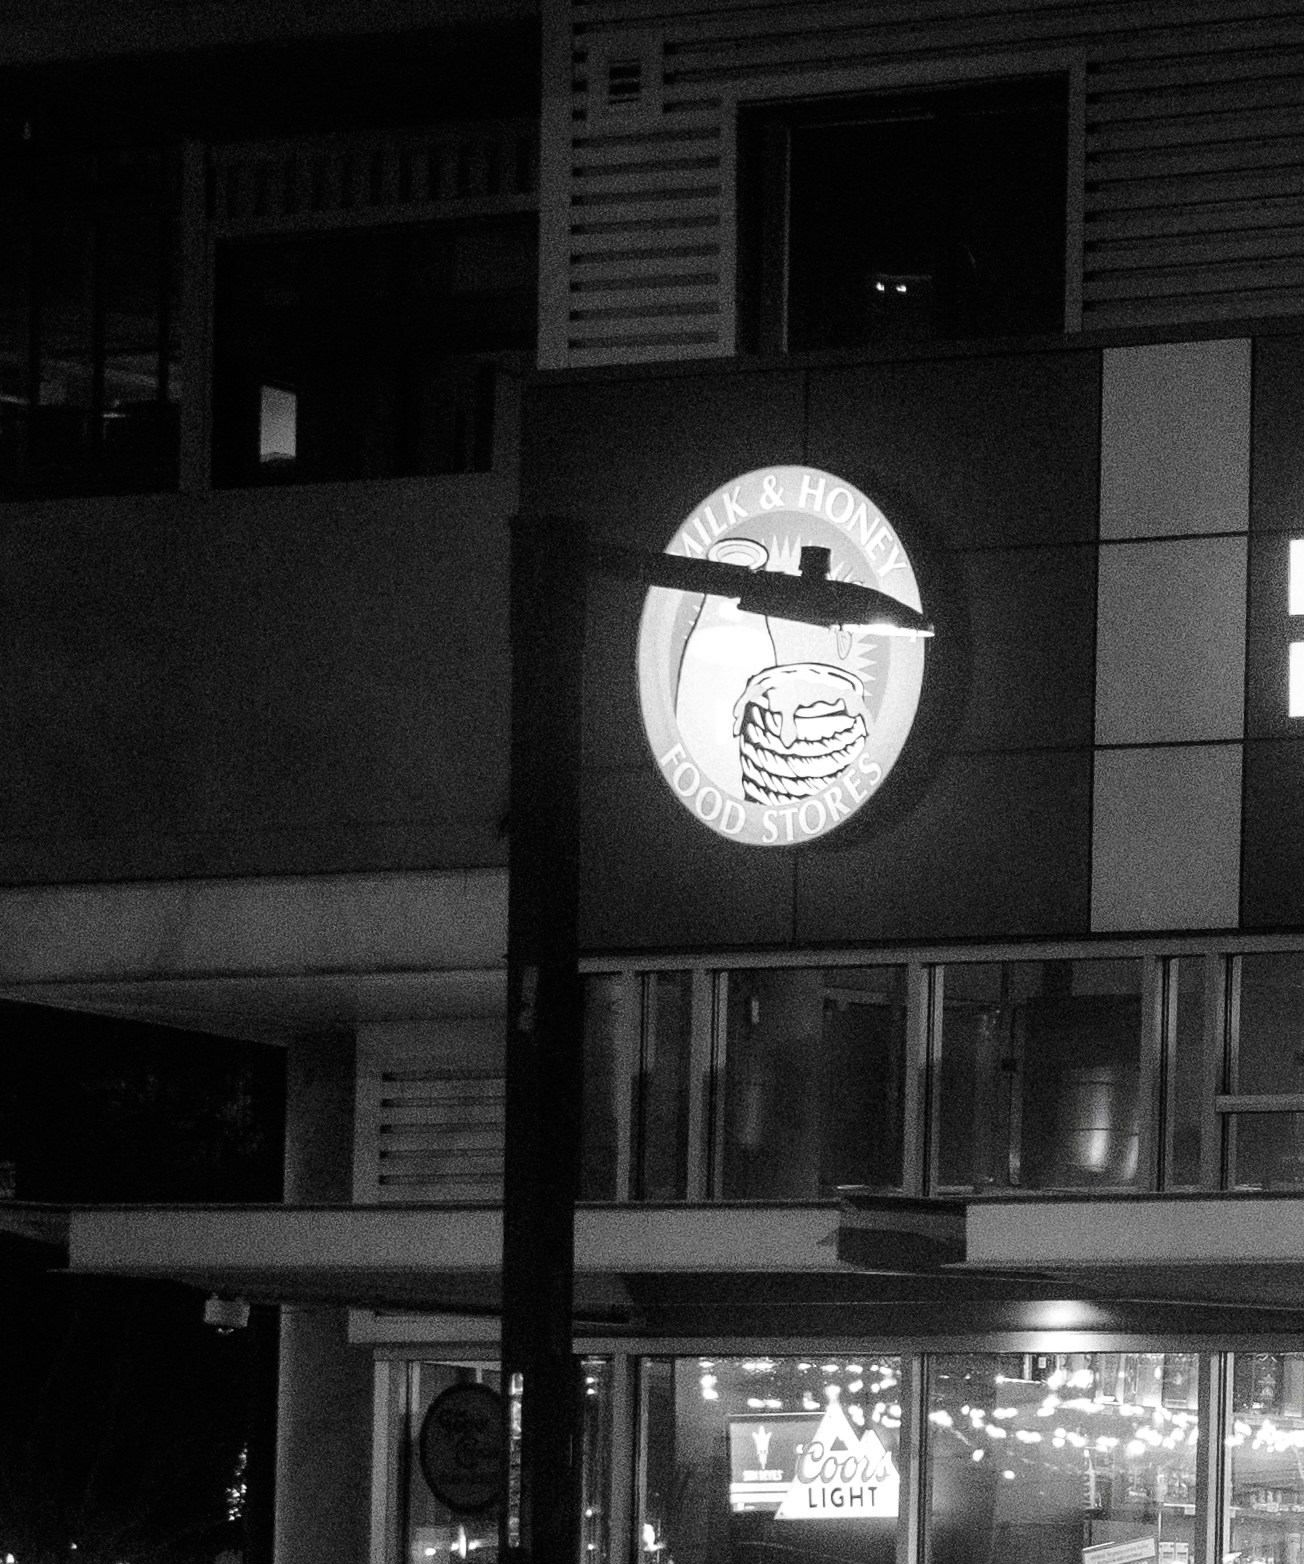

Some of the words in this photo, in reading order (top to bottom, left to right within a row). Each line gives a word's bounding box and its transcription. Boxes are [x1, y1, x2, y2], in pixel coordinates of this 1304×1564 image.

[760, 475, 785, 510] &
[799, 475, 908, 578] HONEY
[660, 743, 746, 835] FOOD
[762, 751, 882, 843] STORES
[797, 1441, 892, 1484] Coors
[808, 1487, 877, 1508] LIGHT
